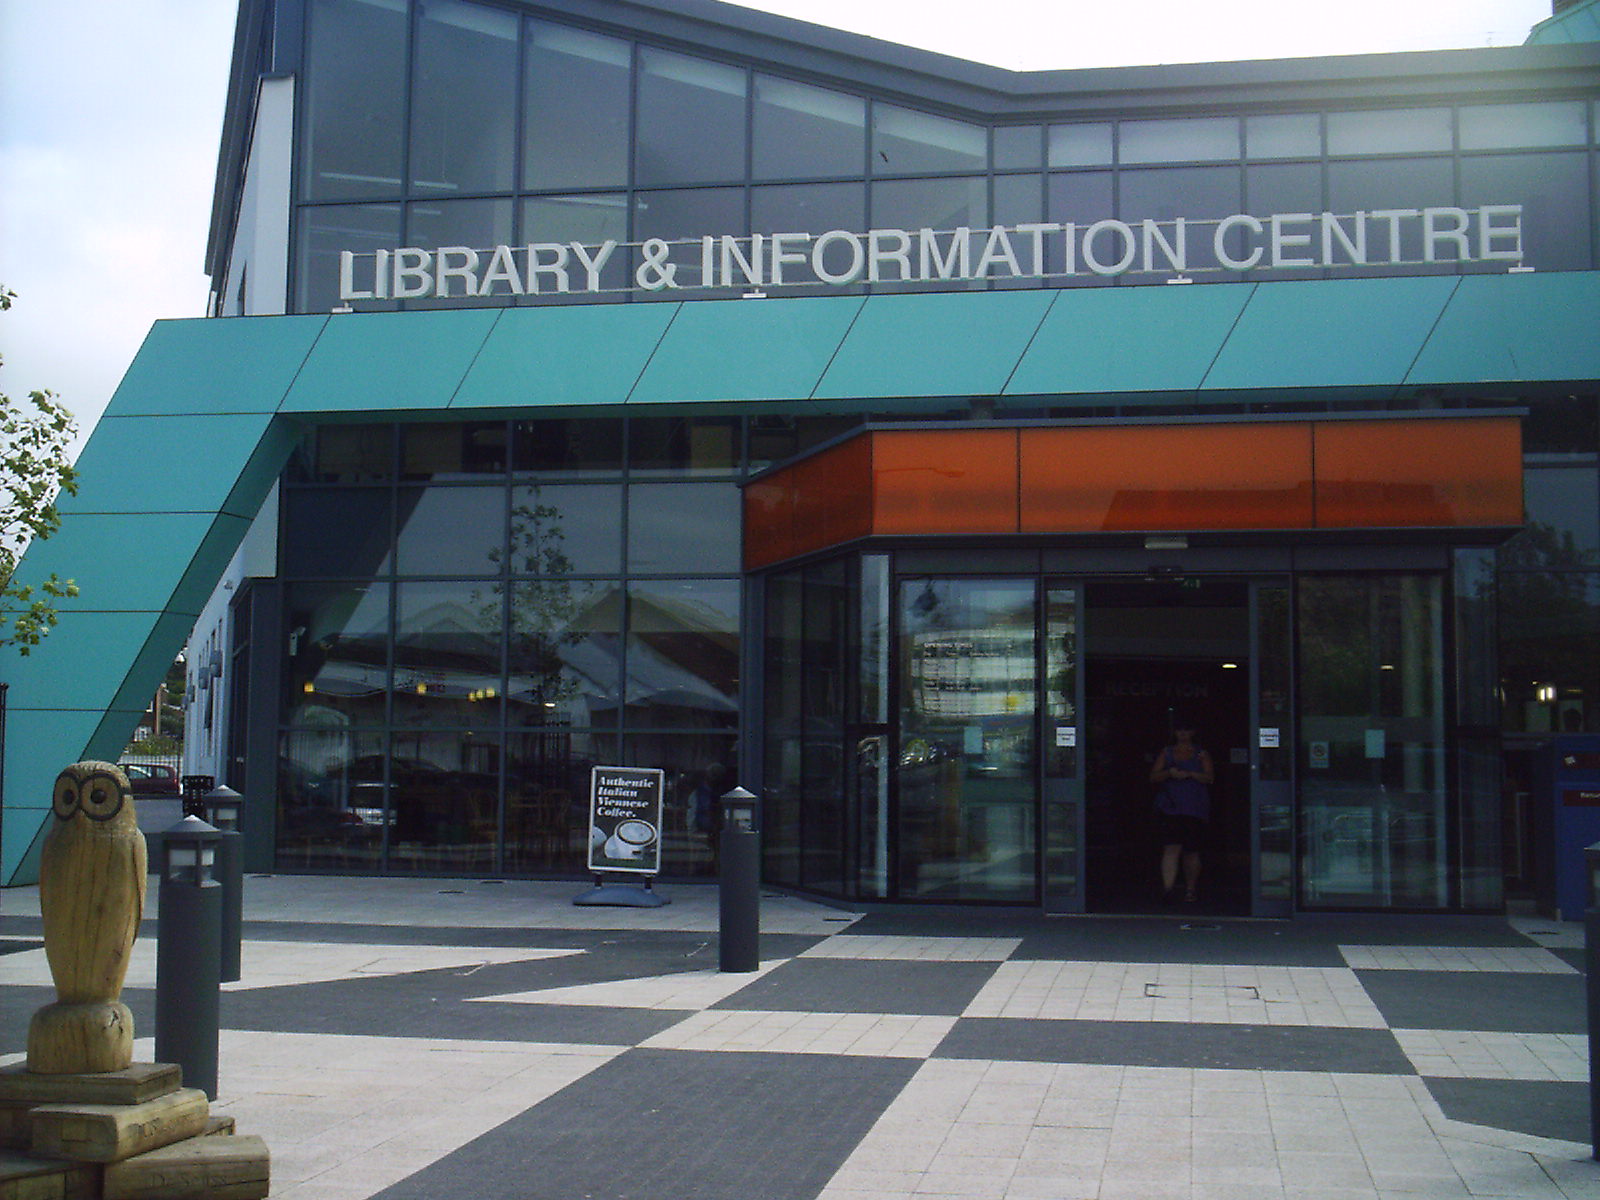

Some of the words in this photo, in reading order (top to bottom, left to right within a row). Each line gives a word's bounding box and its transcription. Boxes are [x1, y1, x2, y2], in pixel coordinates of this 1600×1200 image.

[340, 239, 617, 299] LIBRARY
[636, 238, 680, 291] &
[702, 217, 1186, 287] INFORMATION
[1213, 204, 1523, 271] CENTRE
[598, 776, 654, 788] Authentic
[598, 786, 638, 797] Italian
[598, 796, 649, 808] Viennese
[597, 806, 637, 818] Coffee.
